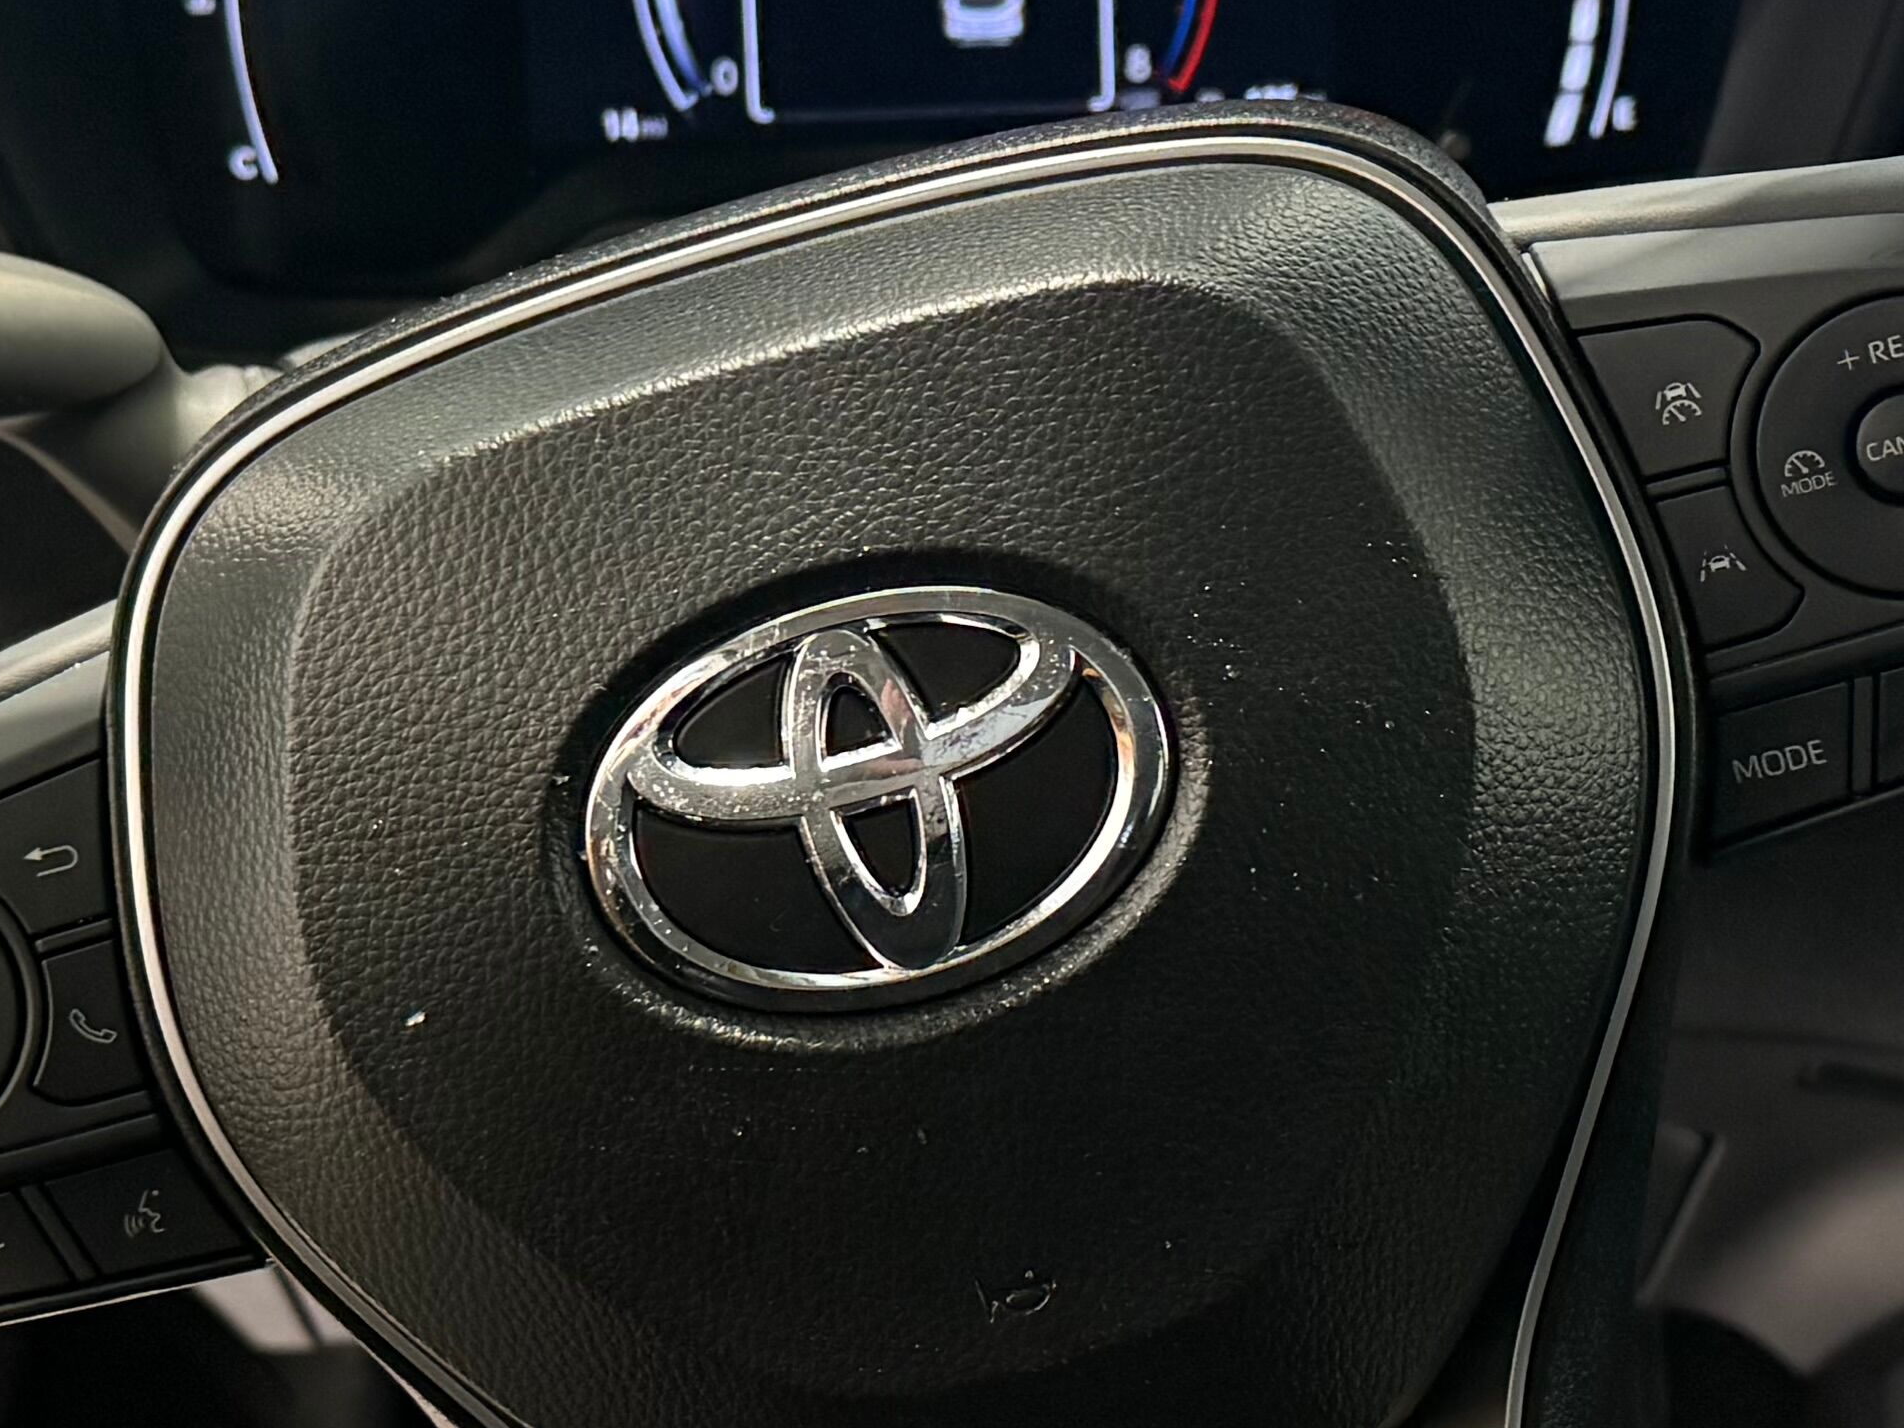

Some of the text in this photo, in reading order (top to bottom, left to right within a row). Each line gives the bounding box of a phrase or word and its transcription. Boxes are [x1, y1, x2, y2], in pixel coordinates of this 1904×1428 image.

[710, 56, 738, 96] 0
[1125, 44, 1152, 84] 8
[229, 145, 258, 180] C
[1781, 471, 1838, 497] MODE
[1732, 739, 1828, 784] MODE
